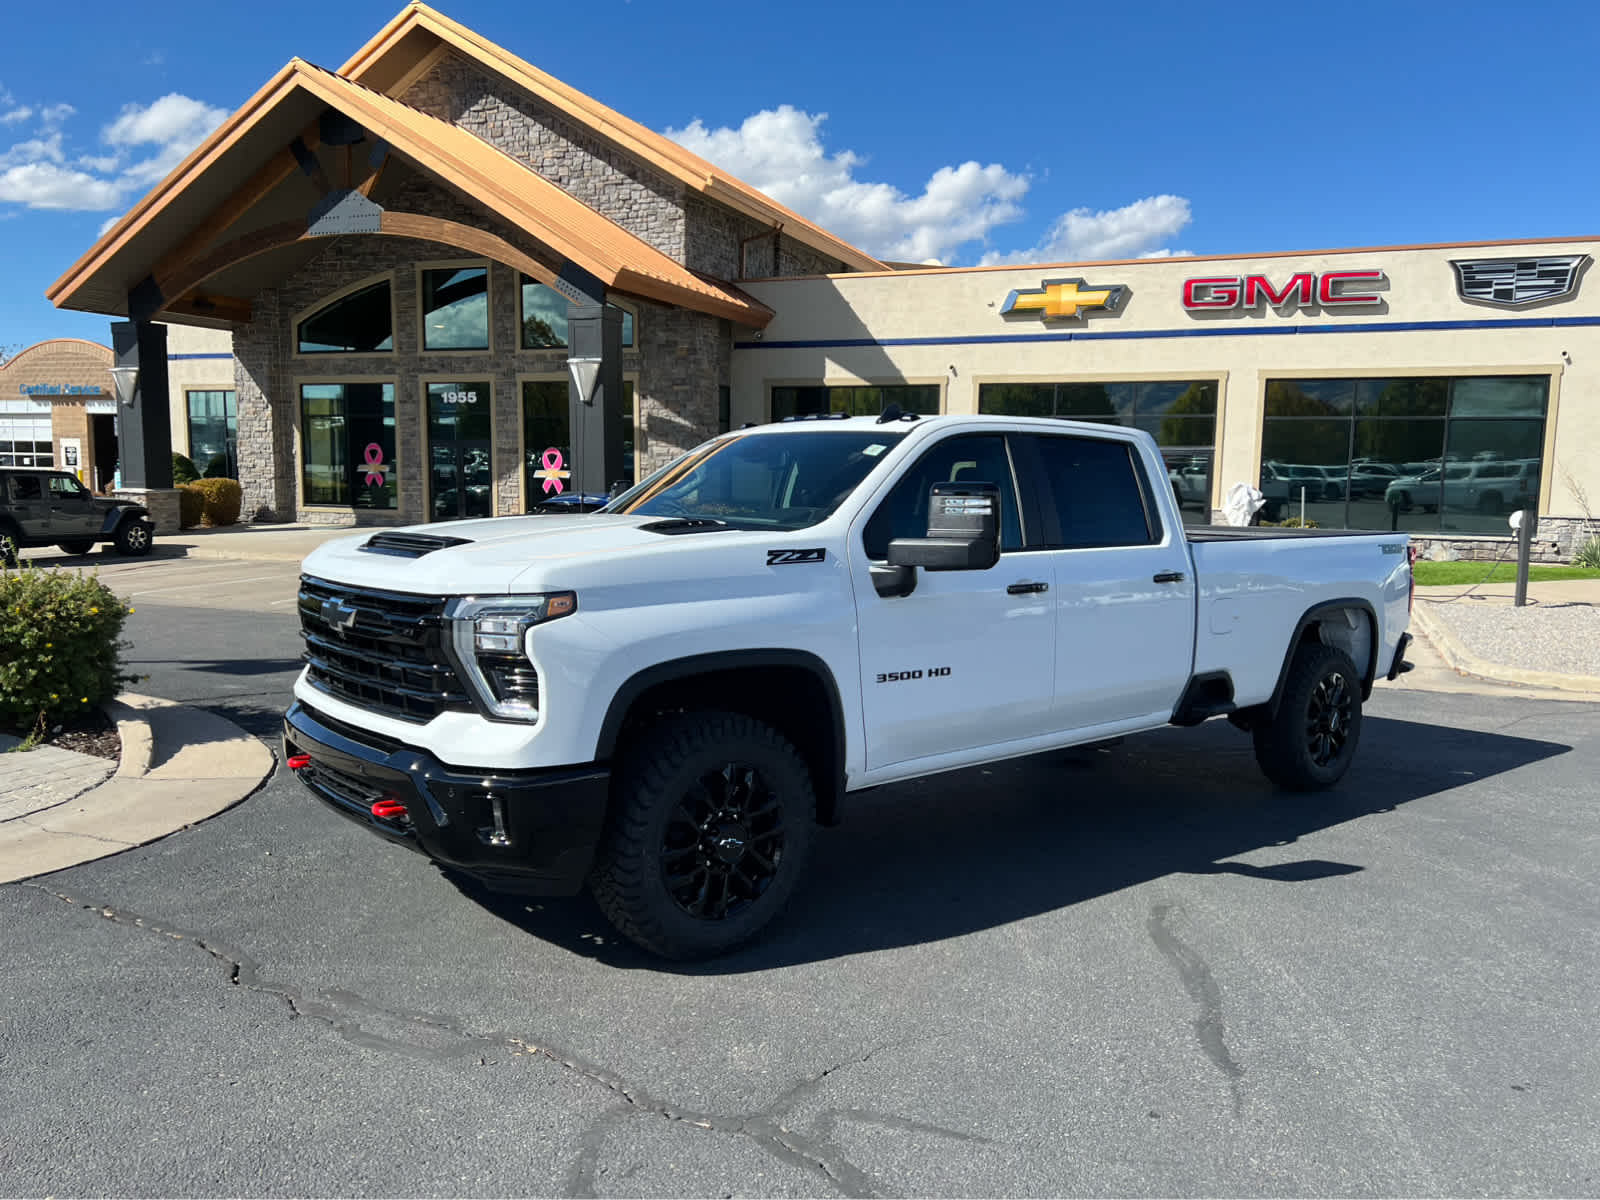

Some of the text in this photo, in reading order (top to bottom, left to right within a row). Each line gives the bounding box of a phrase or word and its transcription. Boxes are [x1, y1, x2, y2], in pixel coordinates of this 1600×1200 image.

[1182, 268, 1385, 311] GMC
[19, 383, 102, 396] Certified Service
[441, 391, 478, 404] 1955
[876, 666, 952, 684] 3500 HD
